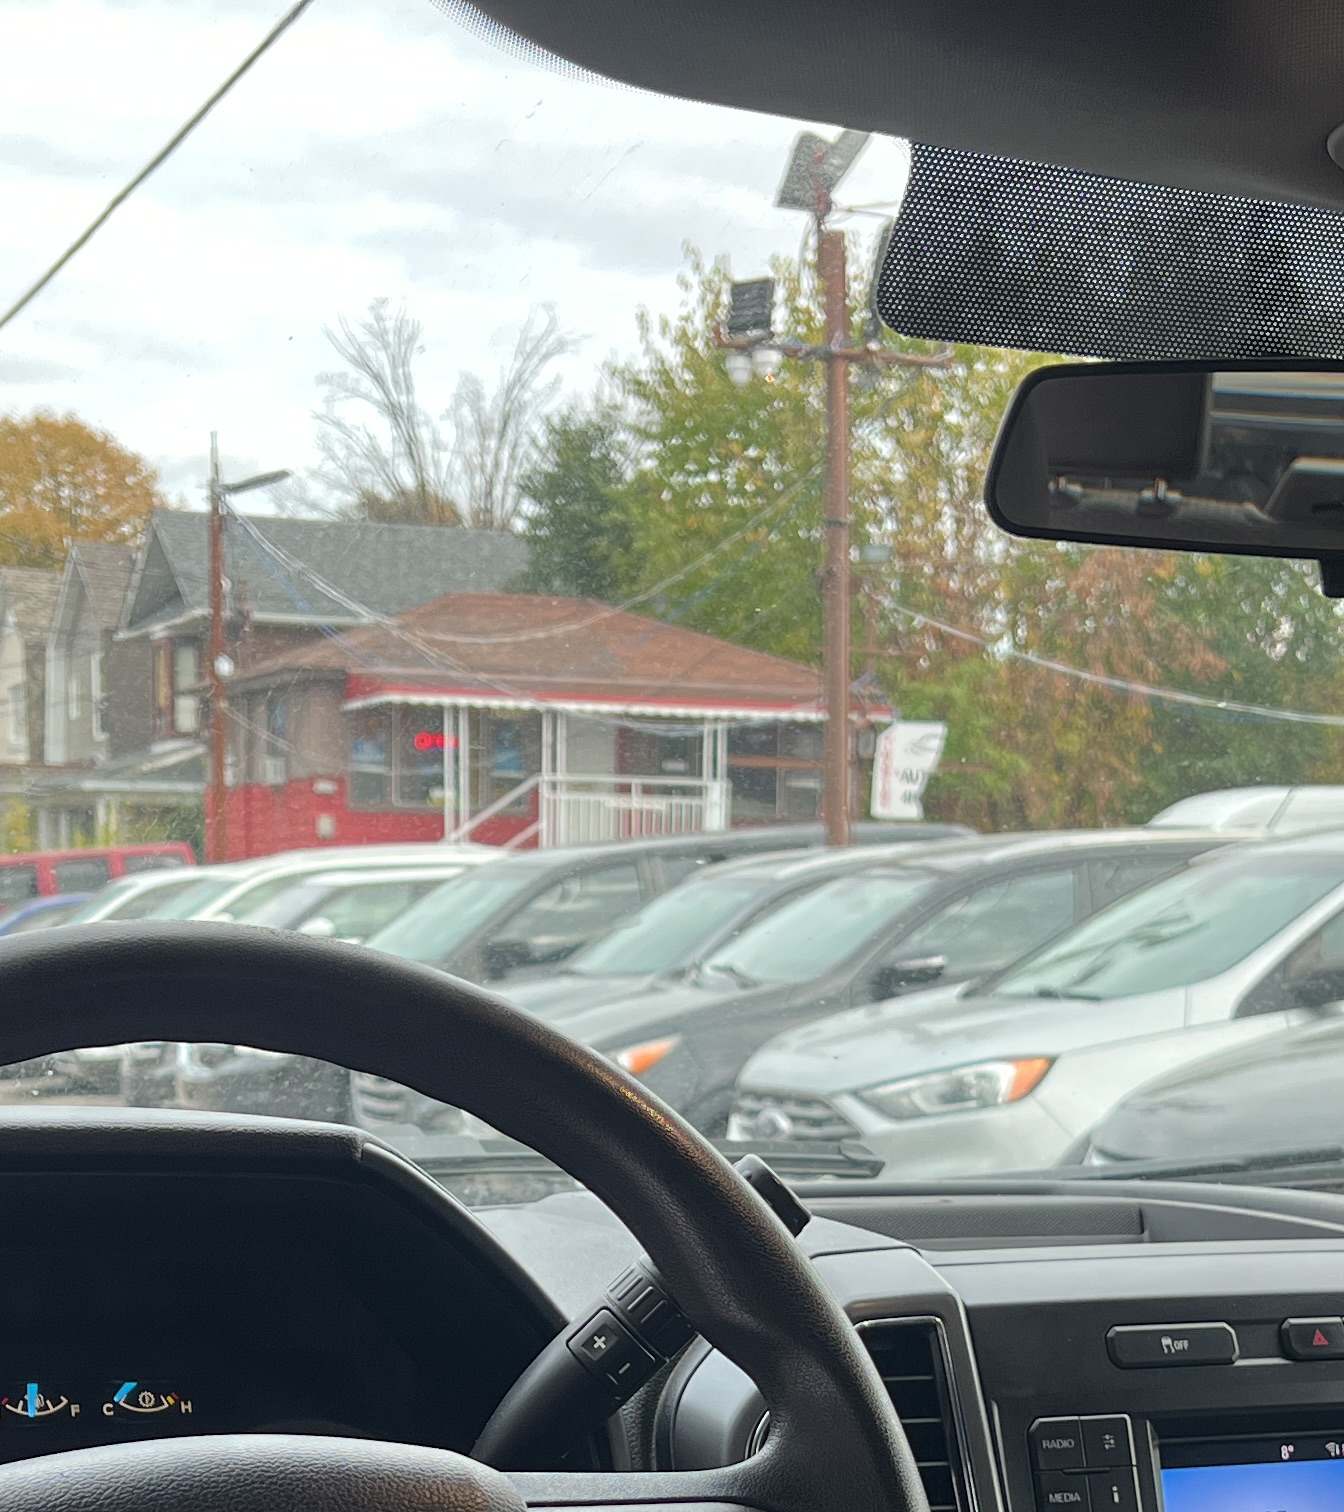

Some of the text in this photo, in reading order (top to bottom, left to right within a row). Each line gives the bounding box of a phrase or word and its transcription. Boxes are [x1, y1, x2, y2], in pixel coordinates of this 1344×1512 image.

[1173, 1339, 1189, 1351] OFF
[69, 1403, 81, 1418] F
[102, 1400, 193, 1416] C H
[1041, 1438, 1075, 1450] RADIO
[1048, 1491, 1082, 1504] MEDIA
